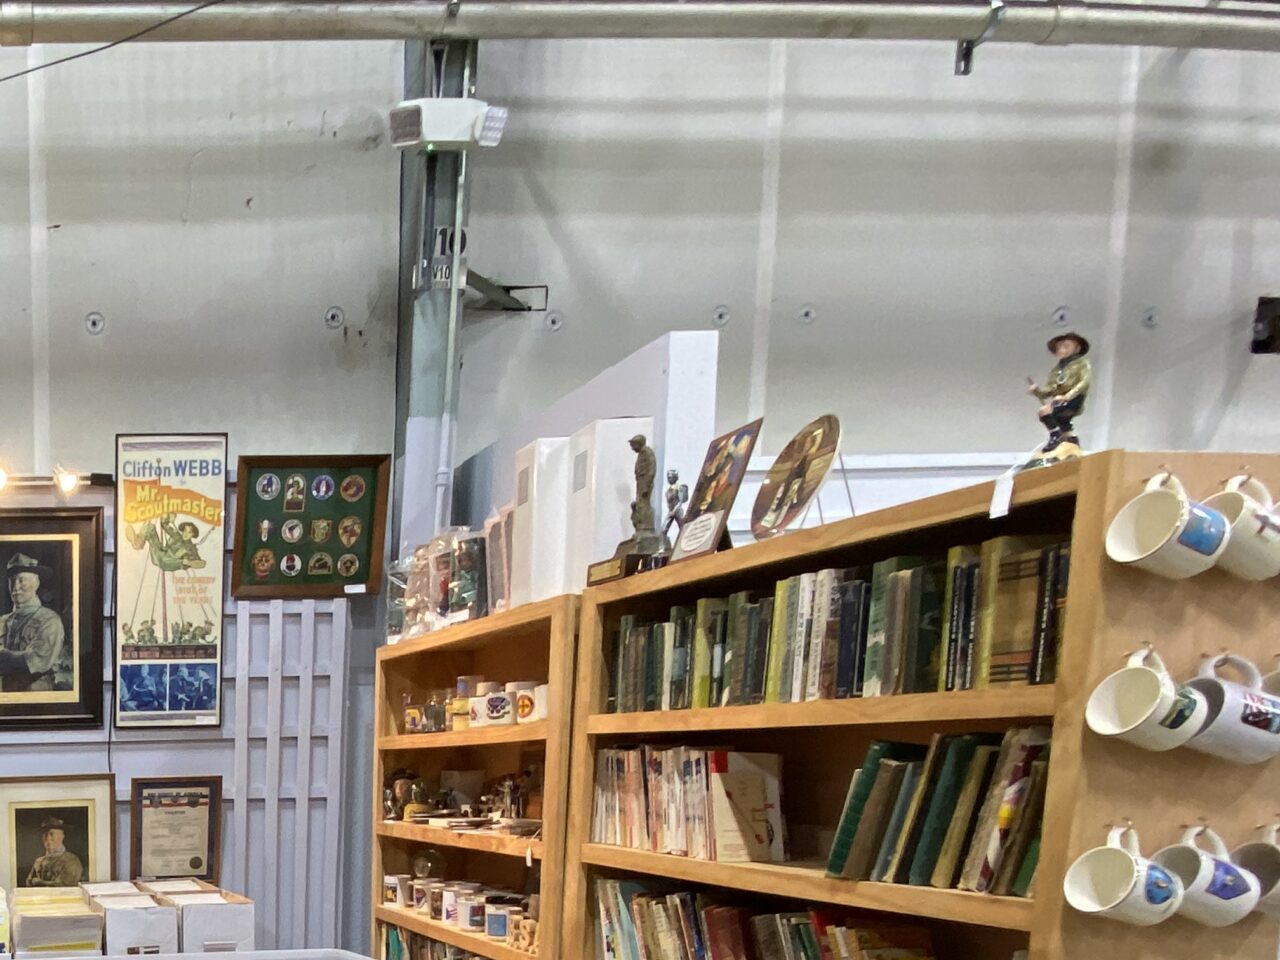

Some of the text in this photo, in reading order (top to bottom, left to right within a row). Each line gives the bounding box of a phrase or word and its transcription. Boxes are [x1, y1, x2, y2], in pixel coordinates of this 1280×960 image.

[434, 227, 467, 256] 10
[432, 265, 451, 280] V10
[123, 459, 223, 478] Clifton WEBB
[136, 484, 161, 501] Mr.
[125, 494, 222, 522] Scoutmaster
